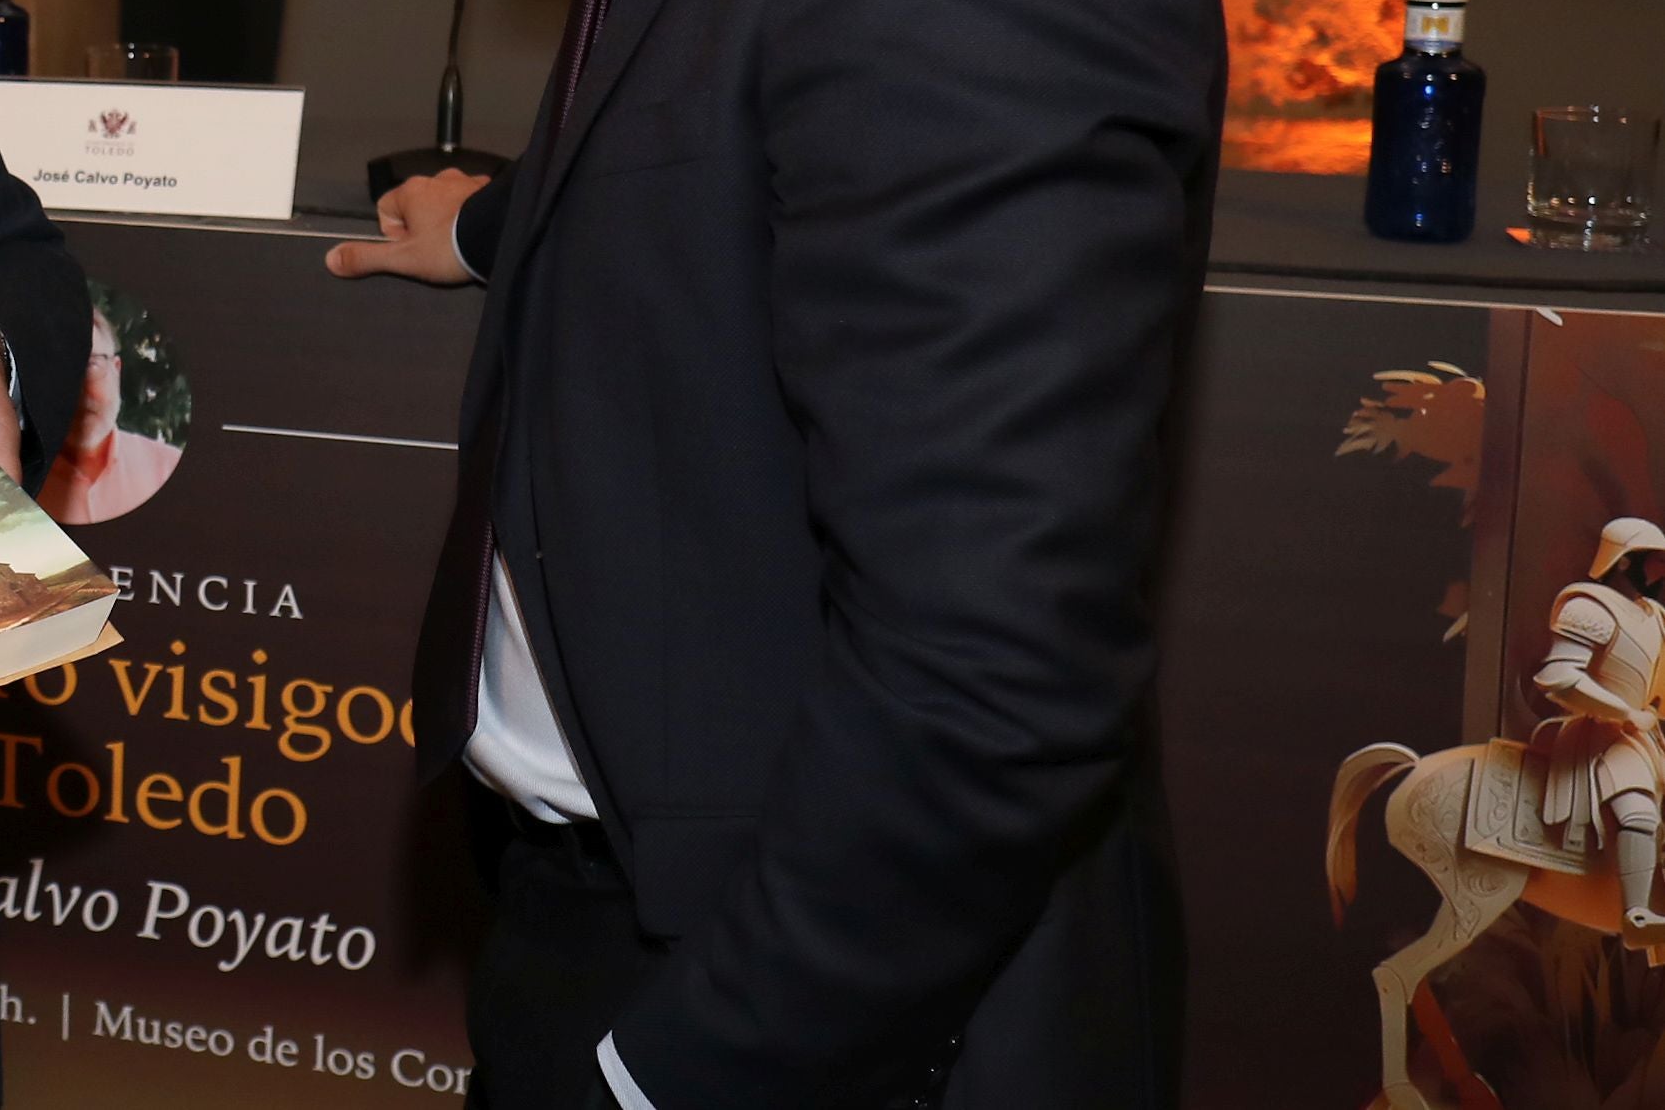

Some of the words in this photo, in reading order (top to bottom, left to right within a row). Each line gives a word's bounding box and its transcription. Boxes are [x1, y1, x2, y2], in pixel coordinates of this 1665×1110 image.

[85, 146, 135, 156] TOLEDO
[33, 169, 70, 182] José
[75, 170, 118, 184] Calvo
[123, 172, 178, 190] Poyato
[136, 881, 377, 973] Poyato
[93, 1000, 234, 1058] Museo
[248, 1026, 299, 1067] de
[313, 1034, 375, 1080] los
